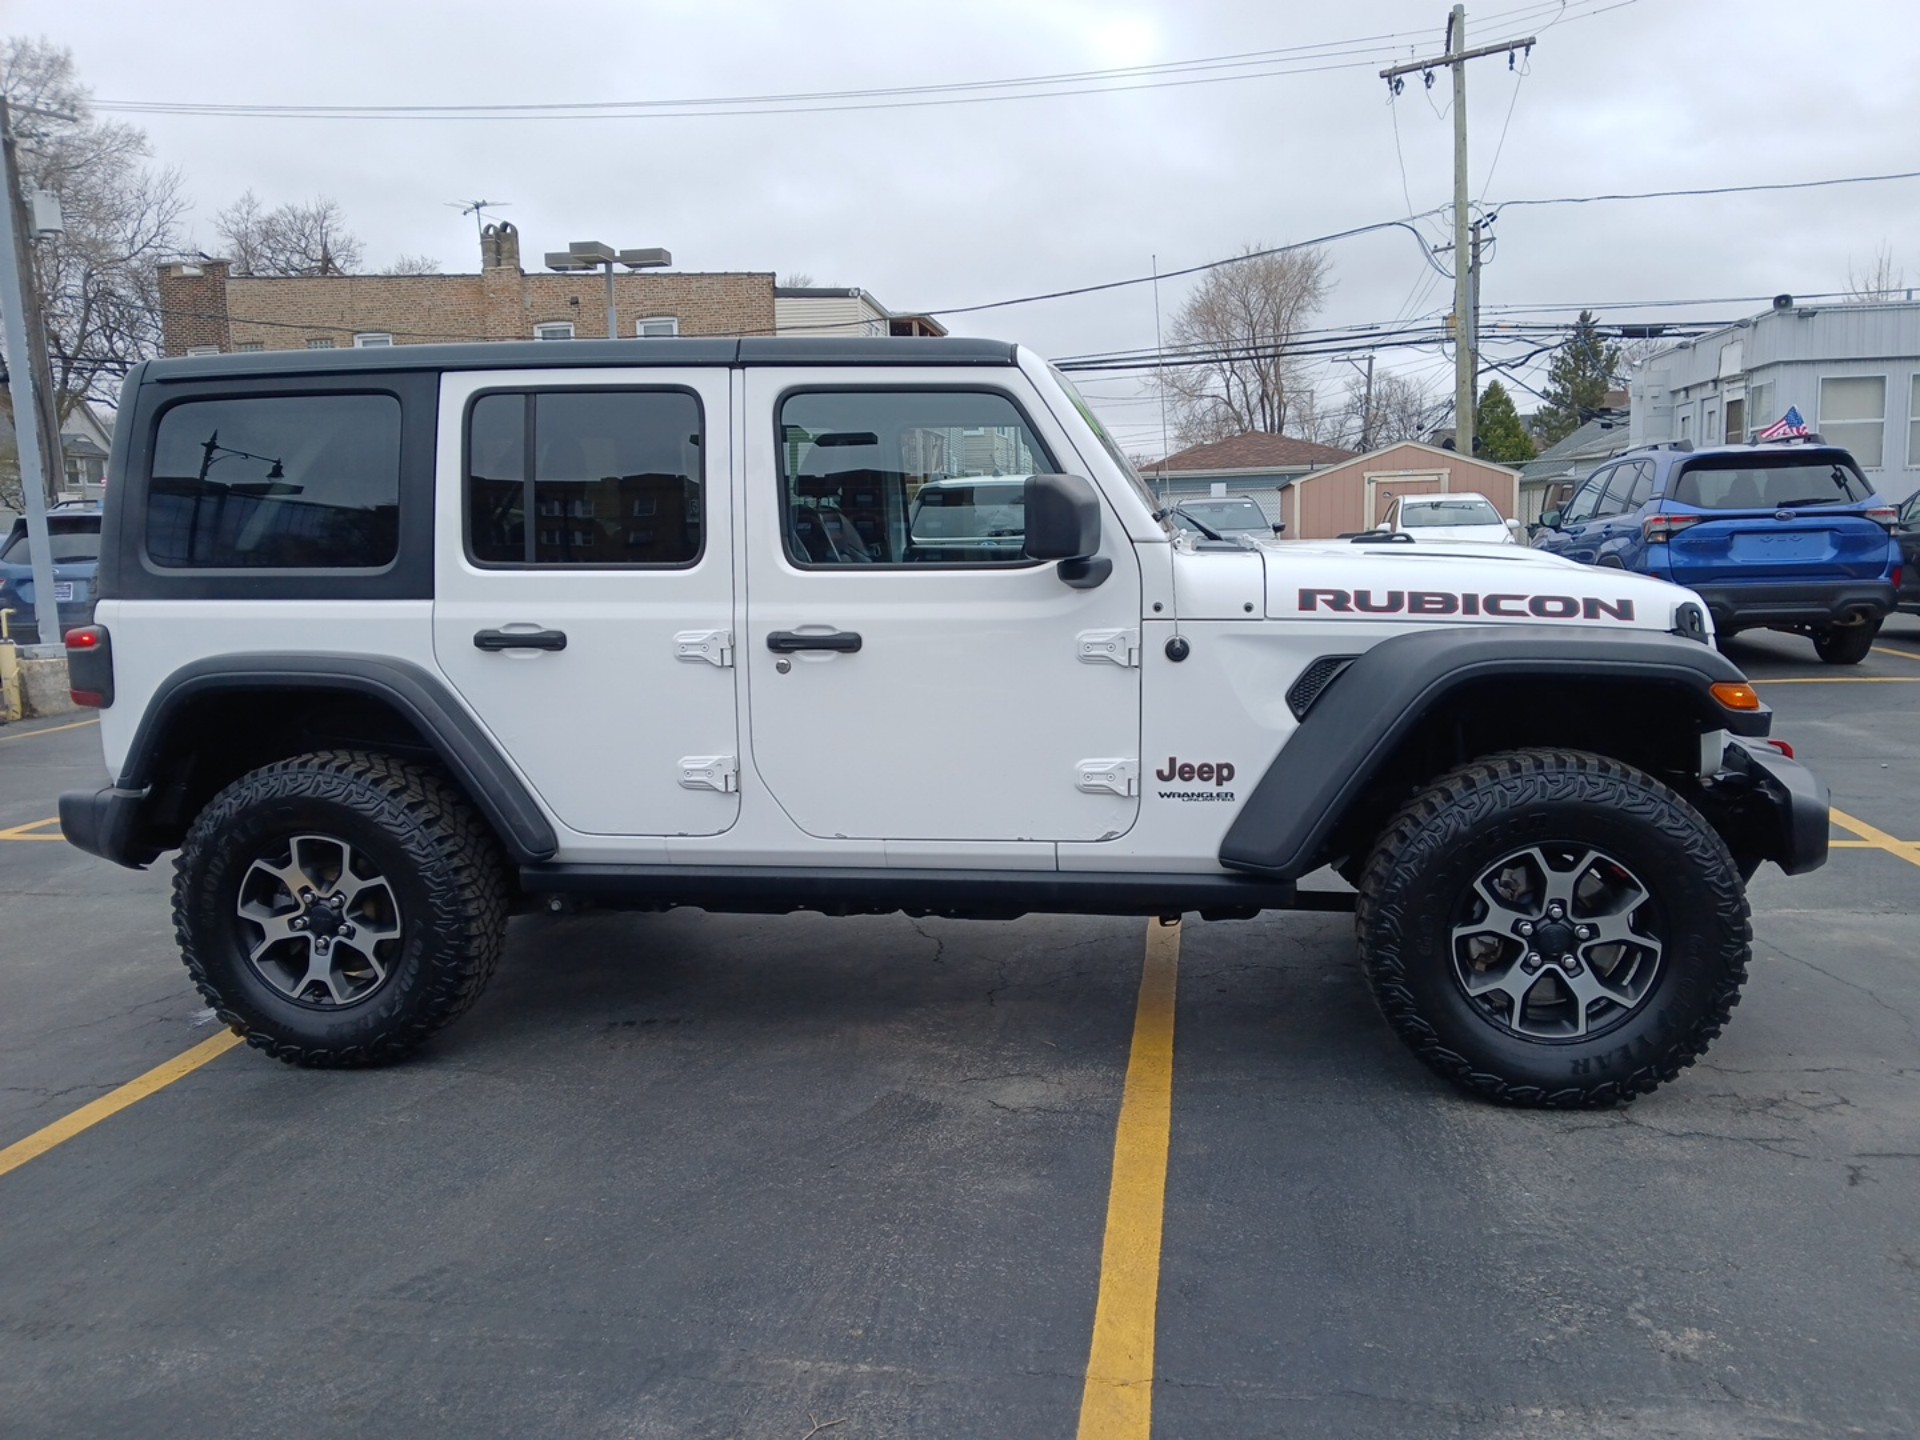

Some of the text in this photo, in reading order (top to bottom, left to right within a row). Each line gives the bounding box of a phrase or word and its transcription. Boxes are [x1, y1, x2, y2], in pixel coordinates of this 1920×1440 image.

[1298, 587, 1635, 621] RUBICON
[1156, 756, 1235, 787] Jeep
[1157, 791, 1234, 799] WRANGLER
